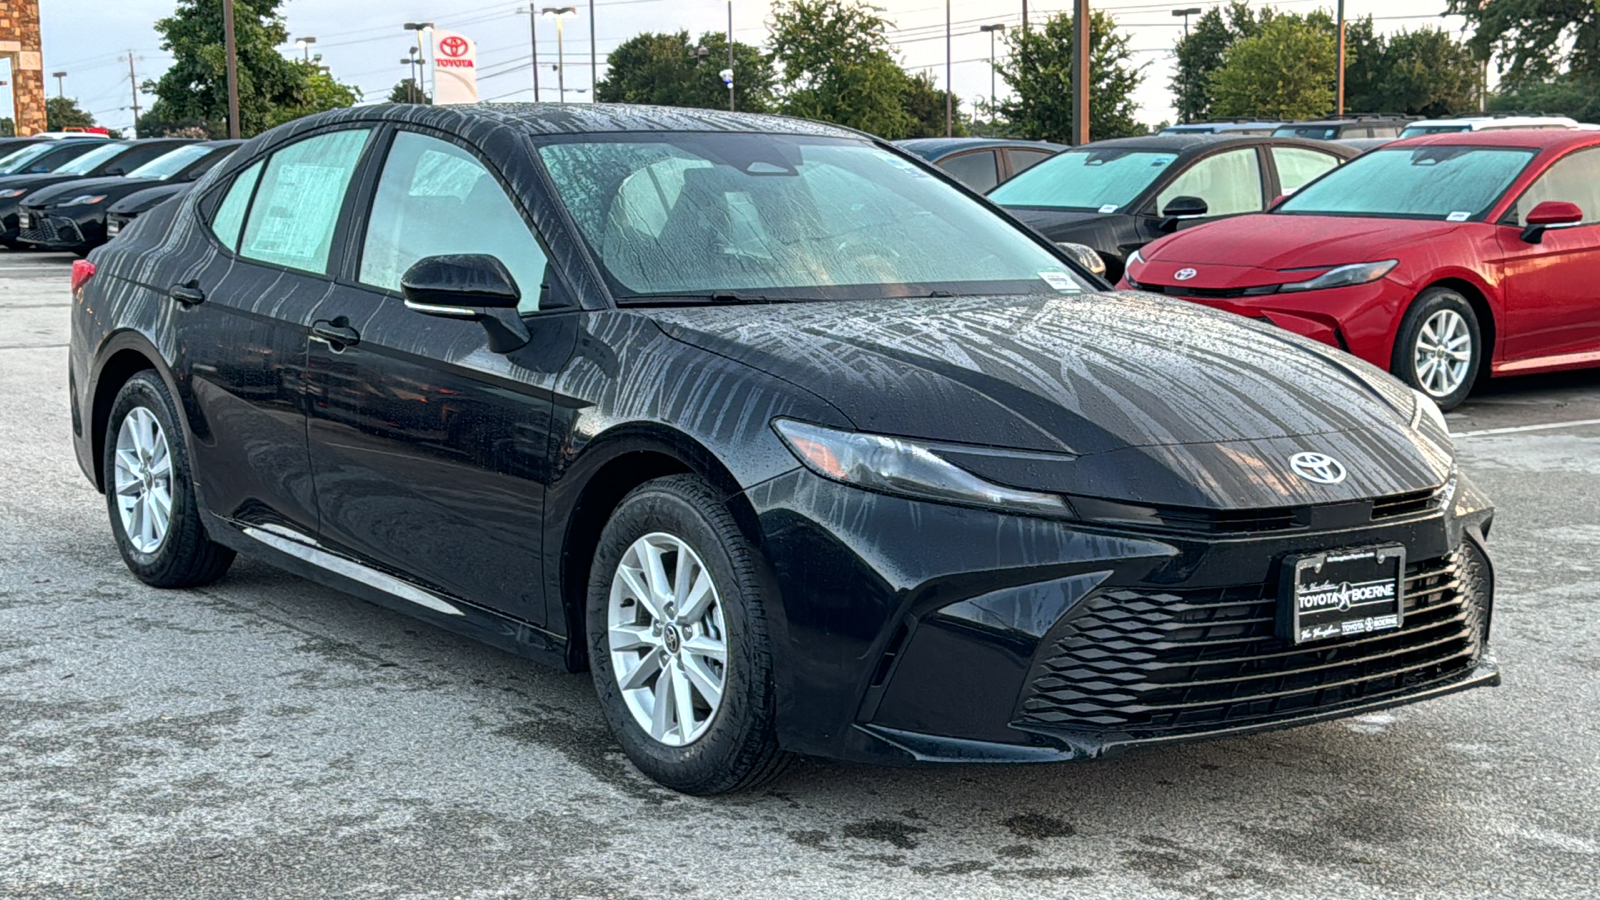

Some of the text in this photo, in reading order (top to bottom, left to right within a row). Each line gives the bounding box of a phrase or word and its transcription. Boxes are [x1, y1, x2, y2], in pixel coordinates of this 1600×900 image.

[435, 58, 474, 67] TOYOTA
[1299, 592, 1338, 608] TOYOTA
[1352, 583, 1395, 601] BOERNE
